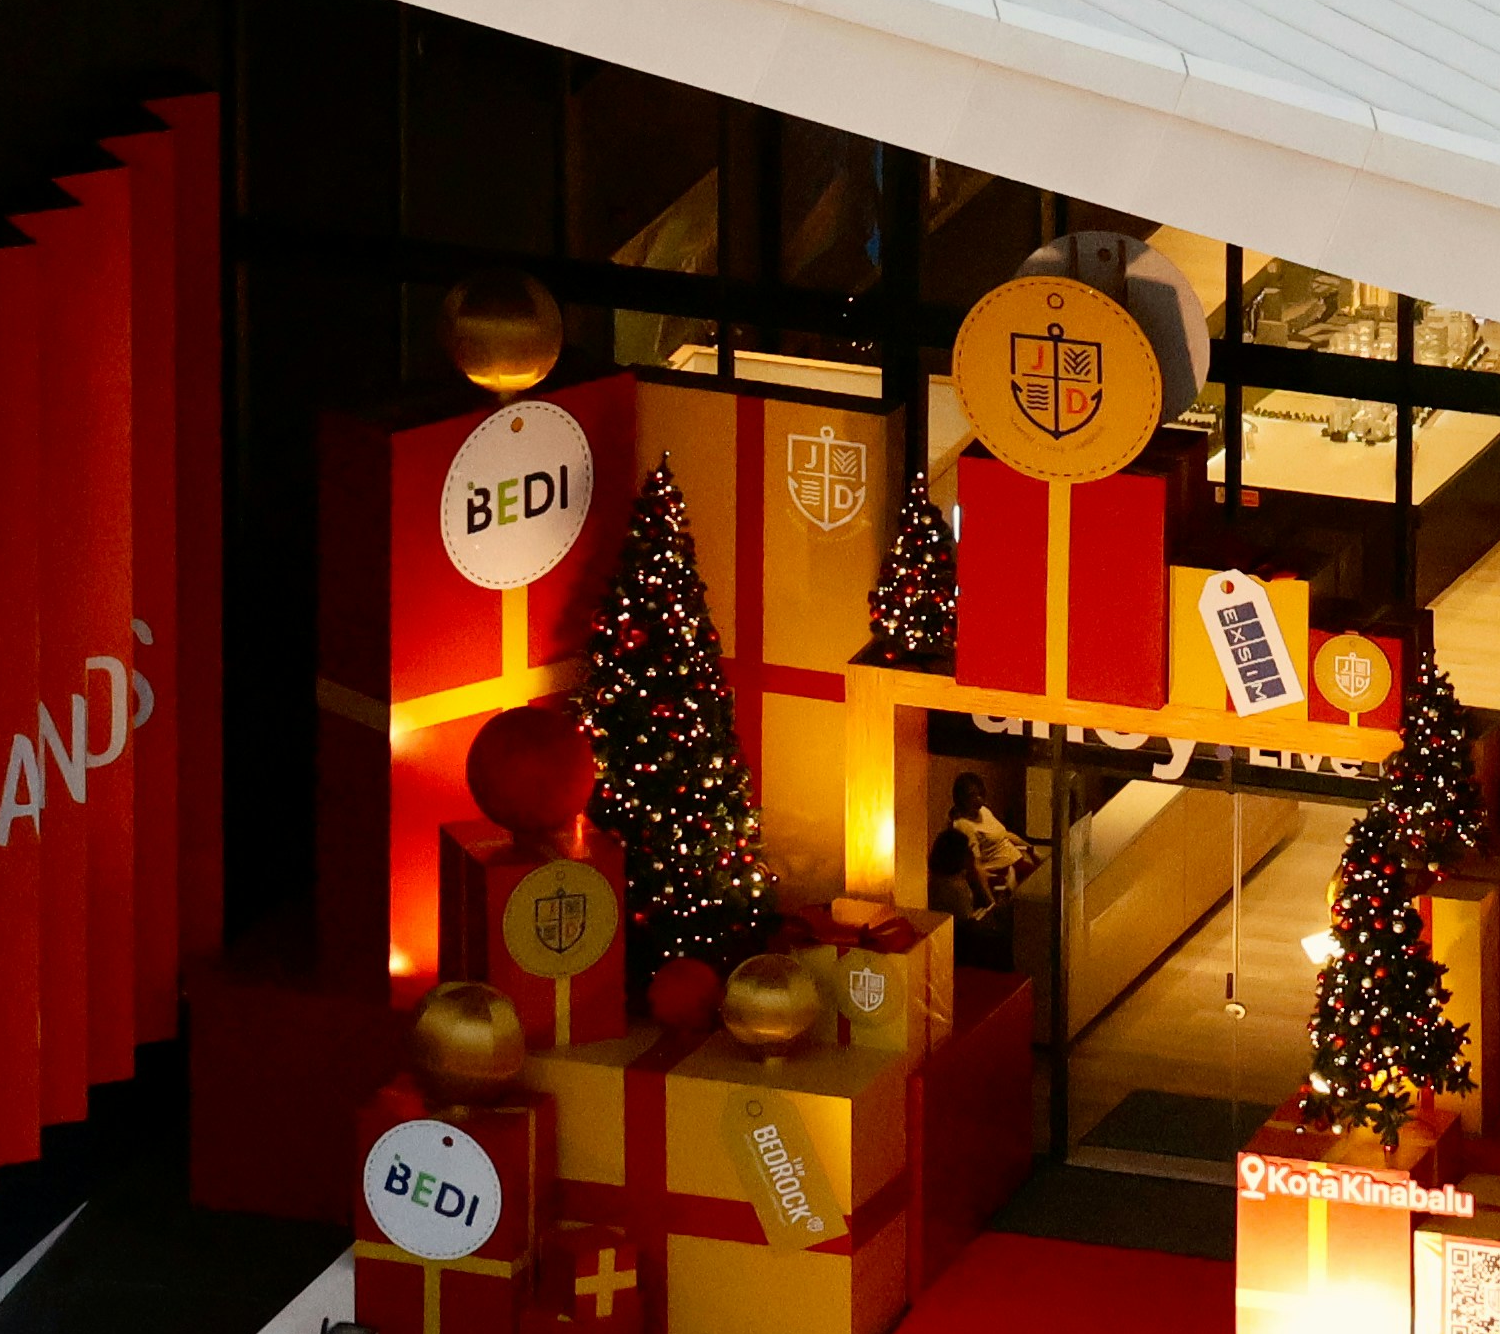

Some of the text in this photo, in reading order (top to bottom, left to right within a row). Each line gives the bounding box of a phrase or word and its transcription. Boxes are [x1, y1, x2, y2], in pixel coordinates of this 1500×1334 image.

[467, 464, 569, 535] BEDI
[1223, 608, 1268, 703] EXSIM
[384, 1153, 480, 1227] BEDI
[753, 1124, 812, 1224] BEDROCK
[1267, 1164, 1475, 1216] Kota Kinabalu
